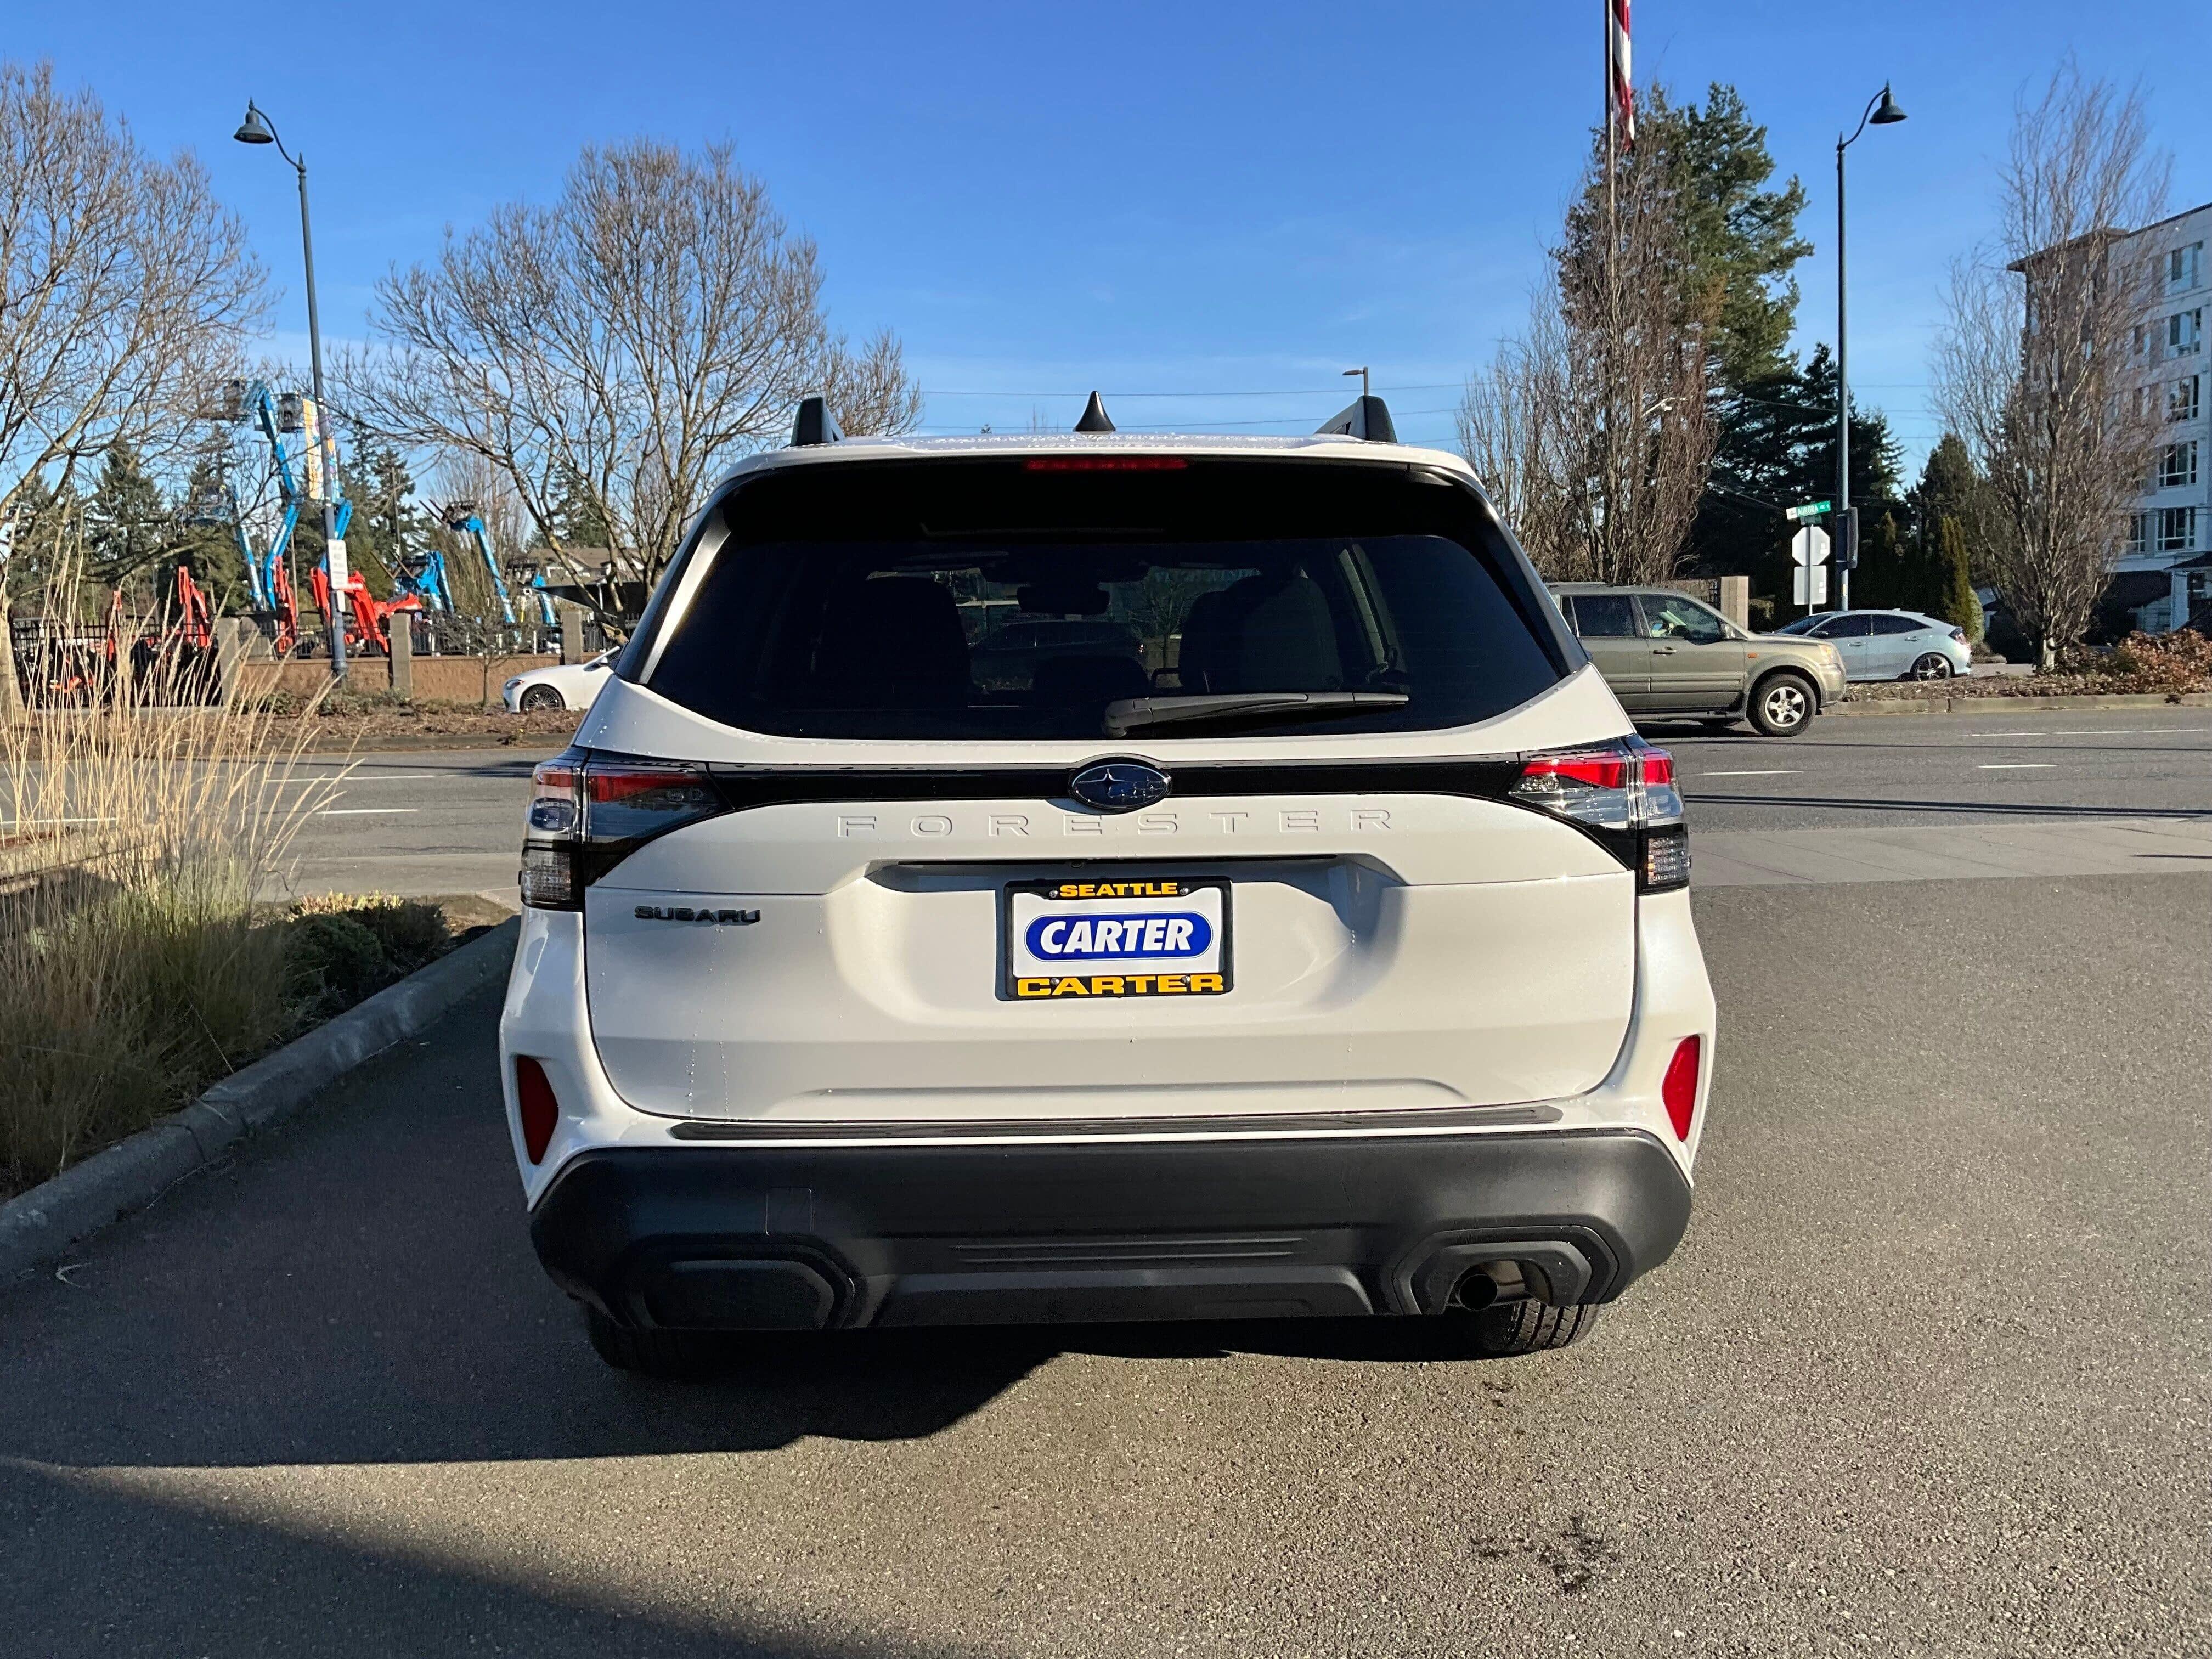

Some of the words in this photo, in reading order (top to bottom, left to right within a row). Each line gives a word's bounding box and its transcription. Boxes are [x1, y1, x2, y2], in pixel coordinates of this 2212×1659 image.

[838, 809, 1391, 837] FORESTER
[1060, 882, 1177, 897] SEATTLE
[634, 906, 761, 923] SUBARU
[1040, 918, 1193, 953] CARTER
[1017, 973, 1223, 996] CARTER
